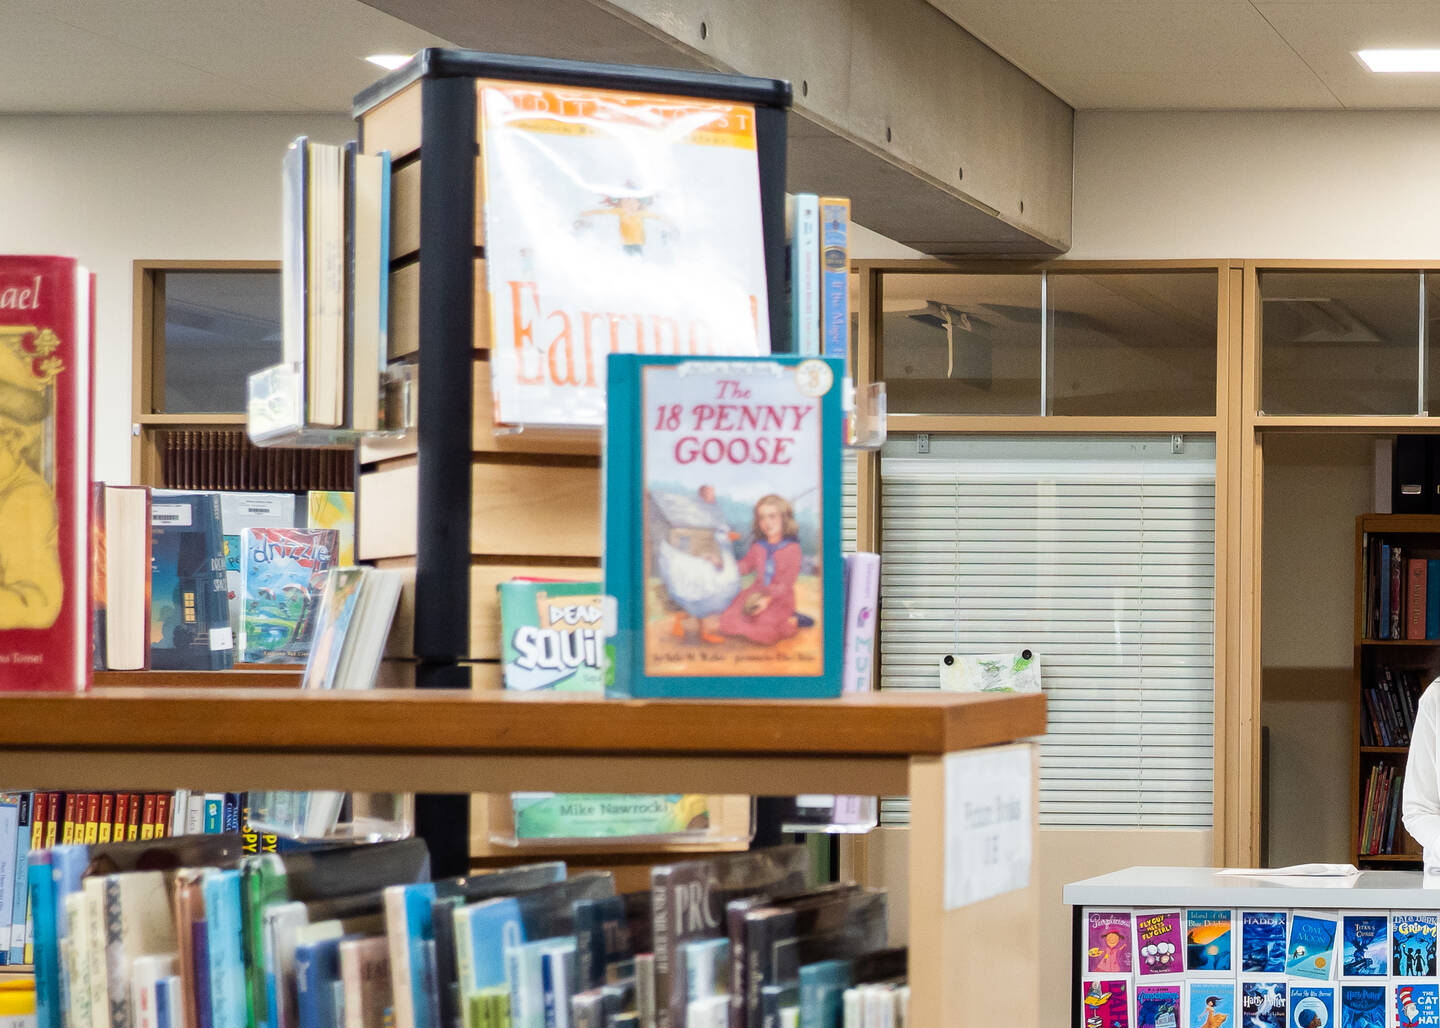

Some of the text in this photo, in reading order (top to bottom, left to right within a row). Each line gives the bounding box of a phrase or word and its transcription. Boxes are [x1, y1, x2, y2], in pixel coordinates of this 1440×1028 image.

[715, 380, 751, 400] The
[654, 404, 814, 432] 18 PENNY
[673, 437, 796, 466] GOOSE
[252, 537, 331, 564] drizzle
[559, 799, 670, 817] Mike Nawrocki
[1243, 917, 1286, 926] HADDIX
[1417, 996, 1439, 1005] CAT
[1418, 1015, 1439, 1025] HAT
